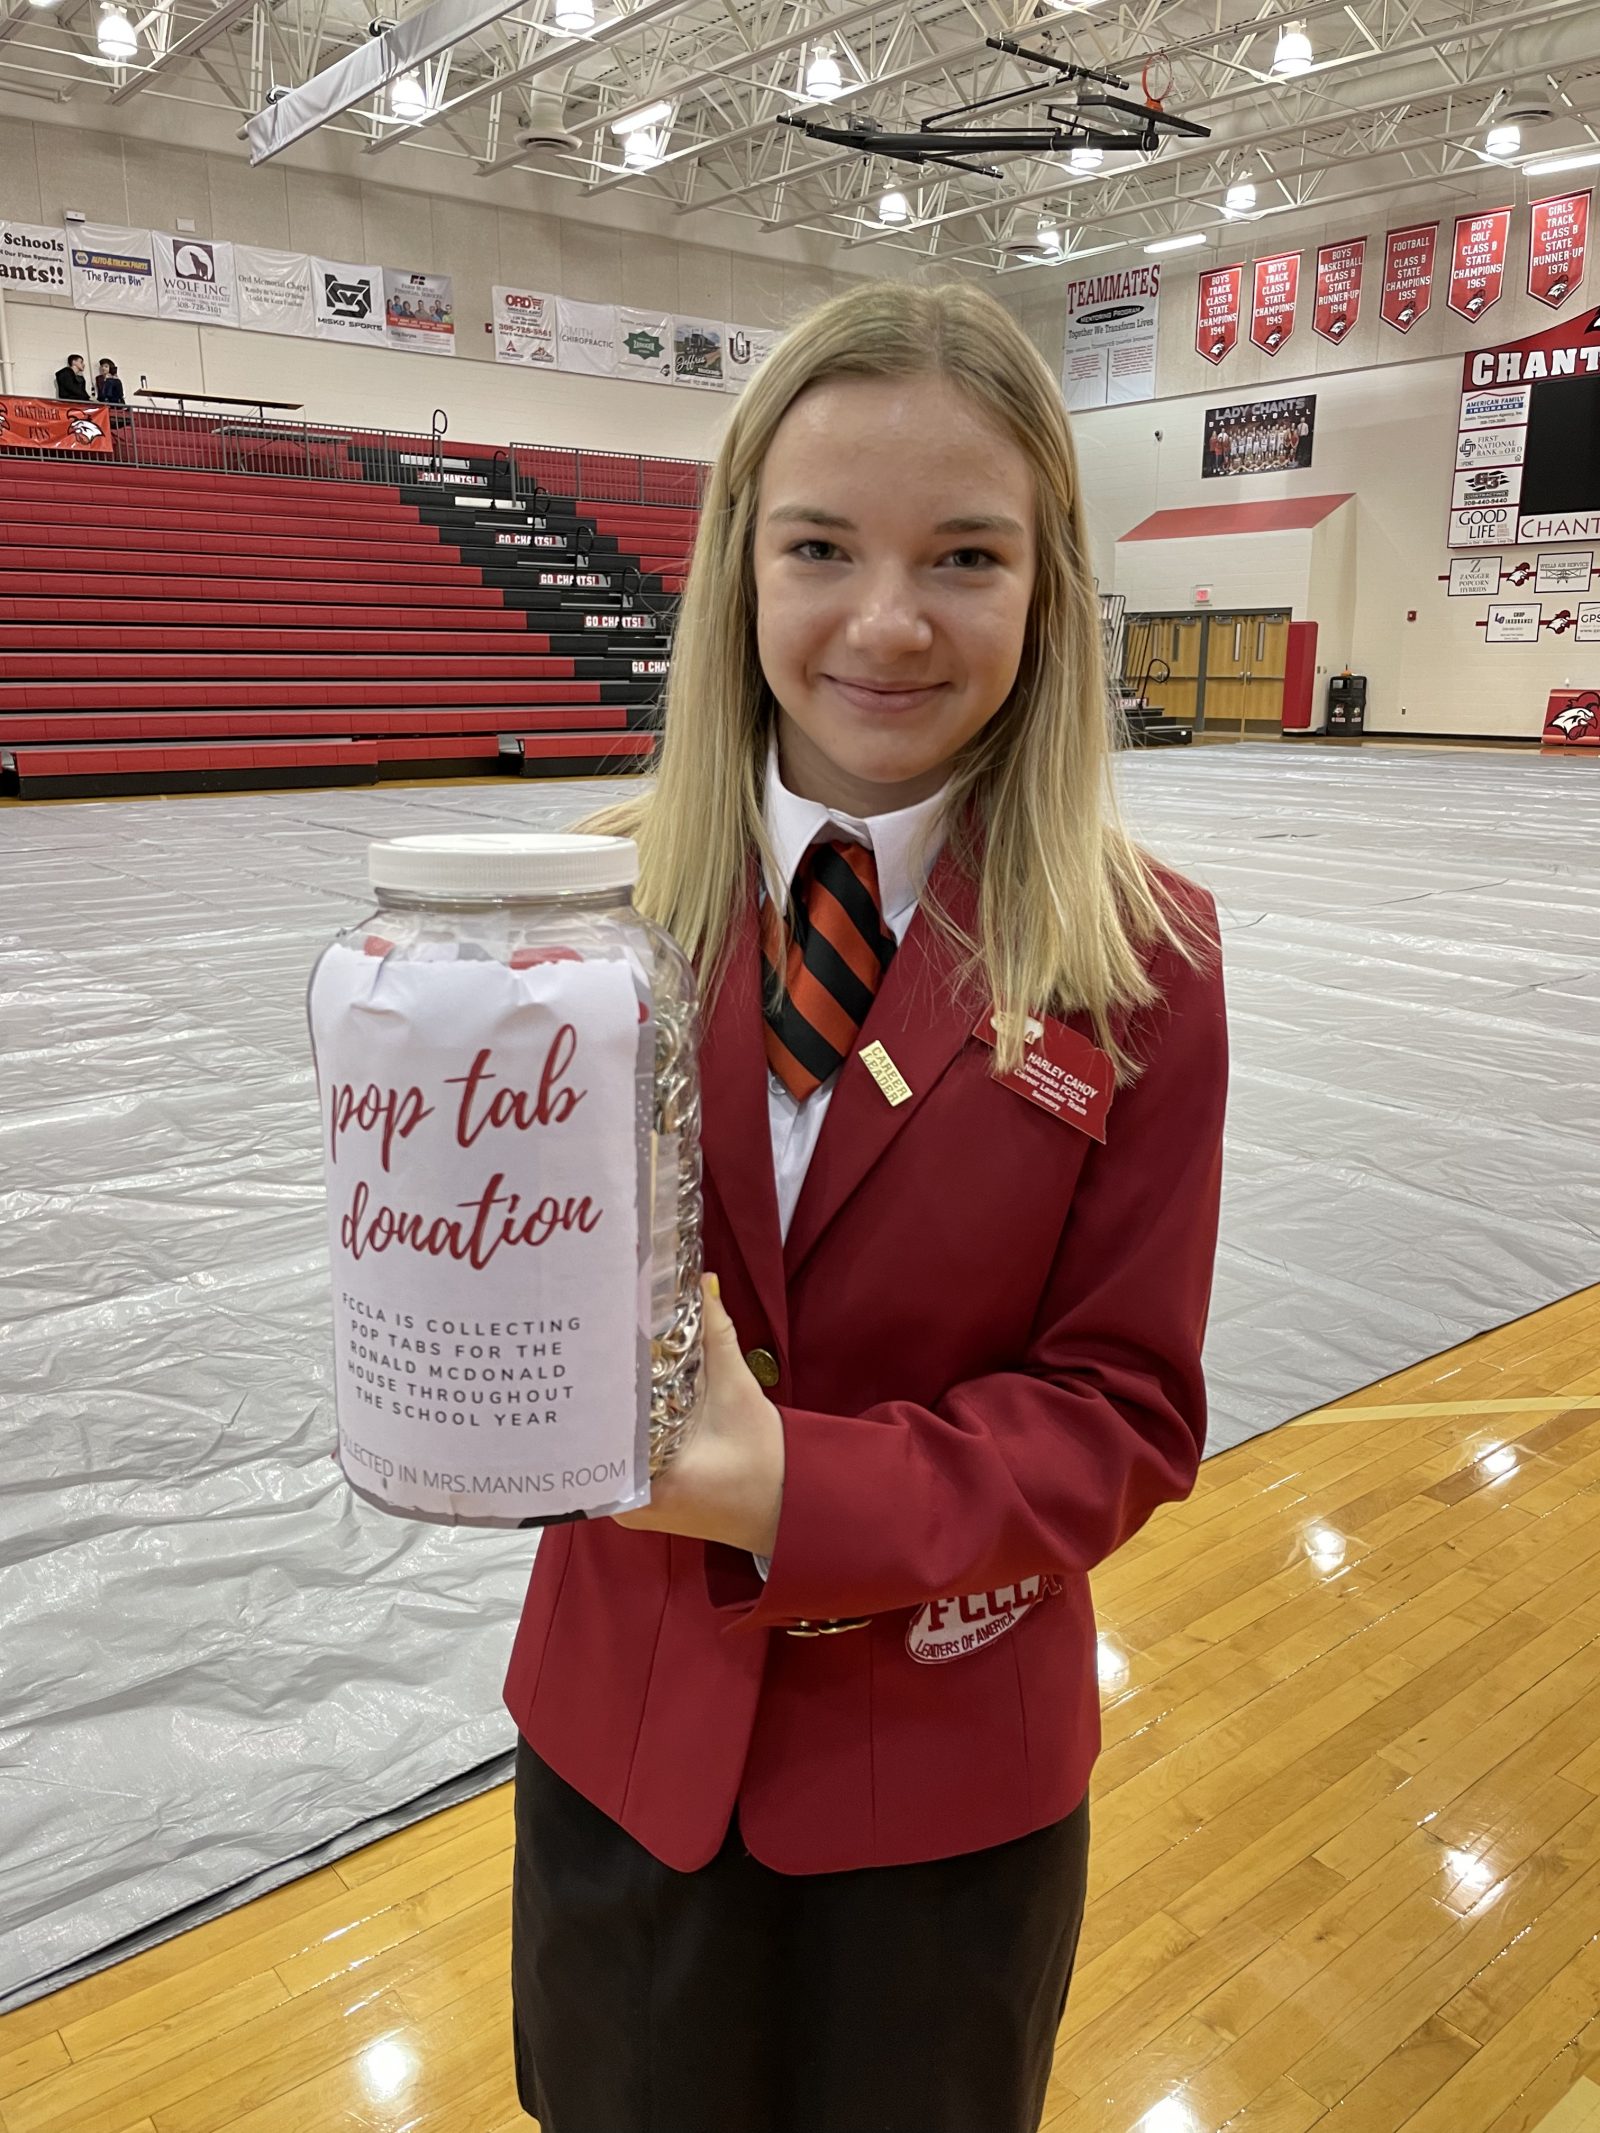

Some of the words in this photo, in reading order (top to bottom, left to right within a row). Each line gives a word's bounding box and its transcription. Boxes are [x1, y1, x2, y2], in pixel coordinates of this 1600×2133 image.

[1548, 202, 1574, 217] GIRLS
[1471, 219, 1494, 231] BOYS
[1546, 214, 1575, 229] TRACK
[1471, 230, 1490, 243] GOLF
[1541, 228, 1570, 242] CLASS
[1572, 224, 1579, 236] B
[4, 232, 64, 252] Schools
[1393, 237, 1430, 253] FOOTBALL
[1462, 243, 1489, 256] CLASS
[1491, 240, 1498, 252] B
[1545, 238, 1573, 252] STATE
[1332, 248, 1352, 260] BOYS
[1394, 256, 1420, 268] CLASS
[1420, 254, 1427, 264] B
[1465, 254, 1491, 267] STATE
[1533, 246, 1585, 267] RUNNER-UP
[1268, 262, 1287, 274] BOYS
[1319, 257, 1363, 273] BASKETBALL
[1453, 264, 1503, 280] CHAMPIONS
[1548, 262, 1569, 275] 1976
[104, 272, 127, 285] Parts
[1265, 272, 1289, 284] TRACK
[1325, 270, 1349, 283] CLASS
[1397, 266, 1421, 279] STATE
[163, 277, 199, 292] WOLF
[238, 274, 252, 284] Ord
[253, 277, 285, 288] Memorial
[286, 281, 310, 292] Chapel
[1212, 274, 1230, 286] BOYS
[1328, 281, 1352, 293] STATE
[1386, 275, 1431, 292] CHAMPIONS
[1467, 277, 1486, 290] 1965
[1067, 264, 1161, 315] TEAMMATES
[1209, 284, 1232, 296] TRACK
[1262, 283, 1284, 296] CLASS
[1398, 289, 1417, 301] 1955
[506, 295, 532, 309] ORD
[1206, 295, 1227, 307] CLASS
[1264, 294, 1287, 305] STATE
[1319, 290, 1360, 306] RUNNER-UP
[1113, 306, 1141, 318] PROGRAM
[1209, 305, 1229, 316] STATE
[1255, 302, 1296, 317] CHAMPIONS
[318, 317, 346, 327] MISKO
[349, 321, 383, 332] SPORTS
[1200, 313, 1238, 328] CHAMPIONS
[1266, 315, 1283, 326] 1945
[1068, 328, 1094, 340] Together
[1095, 325, 1104, 335] We
[1105, 320, 1136, 334] Transform
[1137, 318, 1154, 328] Lives
[562, 335, 614, 349] CHIROPRACTIC
[1215, 405, 1250, 421] LADY
[1252, 397, 1306, 416] CHANTS
[1466, 397, 1500, 409] AMERICAN
[1501, 395, 1525, 405] FAMILY
[1469, 403, 1520, 414] INSURANCE
[1208, 408, 1311, 428] BASKETBALL
[1477, 440, 1517, 450] NATIONAL
[1478, 434, 1499, 444] FIRST
[1476, 449, 1497, 457] BANK
[1504, 446, 1523, 455] ORD
[423, 472, 435, 481] GO
[1459, 509, 1508, 526] GOOD
[1469, 524, 1496, 539] LIFE
[499, 534, 512, 544] GO
[1470, 560, 1481, 573] Z
[541, 573, 554, 584] GO
[1460, 573, 1490, 581] ZANGGER
[1460, 586, 1487, 594] HYBRIDS
[586, 616, 599, 627] GO
[632, 661, 645, 673] GO
[863, 1053, 900, 1102] LEADER
[871, 1046, 909, 1097] CAREER
[1026, 1052, 1066, 1080] HARLEY
[1063, 1074, 1099, 1099] CAHOY
[1024, 1063, 1060, 1089] Nebraska
[1060, 1085, 1088, 1105] FCCLA
[332, 1083, 436, 1173] pop
[444, 1023, 588, 1149] tab
[1013, 1068, 1041, 1087] Career
[1040, 1083, 1067, 1103] Leader
[1066, 1099, 1088, 1116] Team
[1031, 1090, 1062, 1112] Secretary
[341, 1172, 603, 1271] donation
[343, 1292, 386, 1323] FCCLA
[396, 1313, 415, 1330] IS
[426, 1317, 582, 1337] COLLECTING
[351, 1319, 379, 1342] POP
[388, 1333, 441, 1356] TABS
[455, 1345, 502, 1359] FOR
[516, 1341, 563, 1357] THE
[351, 1340, 417, 1375] RONALD
[429, 1363, 567, 1383] MCDONALD
[347, 1359, 398, 1393] HOUSE
[407, 1385, 575, 1405] THROUGHOUT
[355, 1385, 384, 1410] THE
[392, 1401, 481, 1427] SCHOOL
[494, 1410, 558, 1427] YEAR
[399, 1463, 417, 1485] IN
[424, 1471, 555, 1495] MRS.MANNS
[562, 1459, 627, 1490] ROOM
[915, 1638, 960, 1659] LEADERS
[961, 1632, 976, 1650] OF
[975, 1611, 1016, 1643] AMERICA
